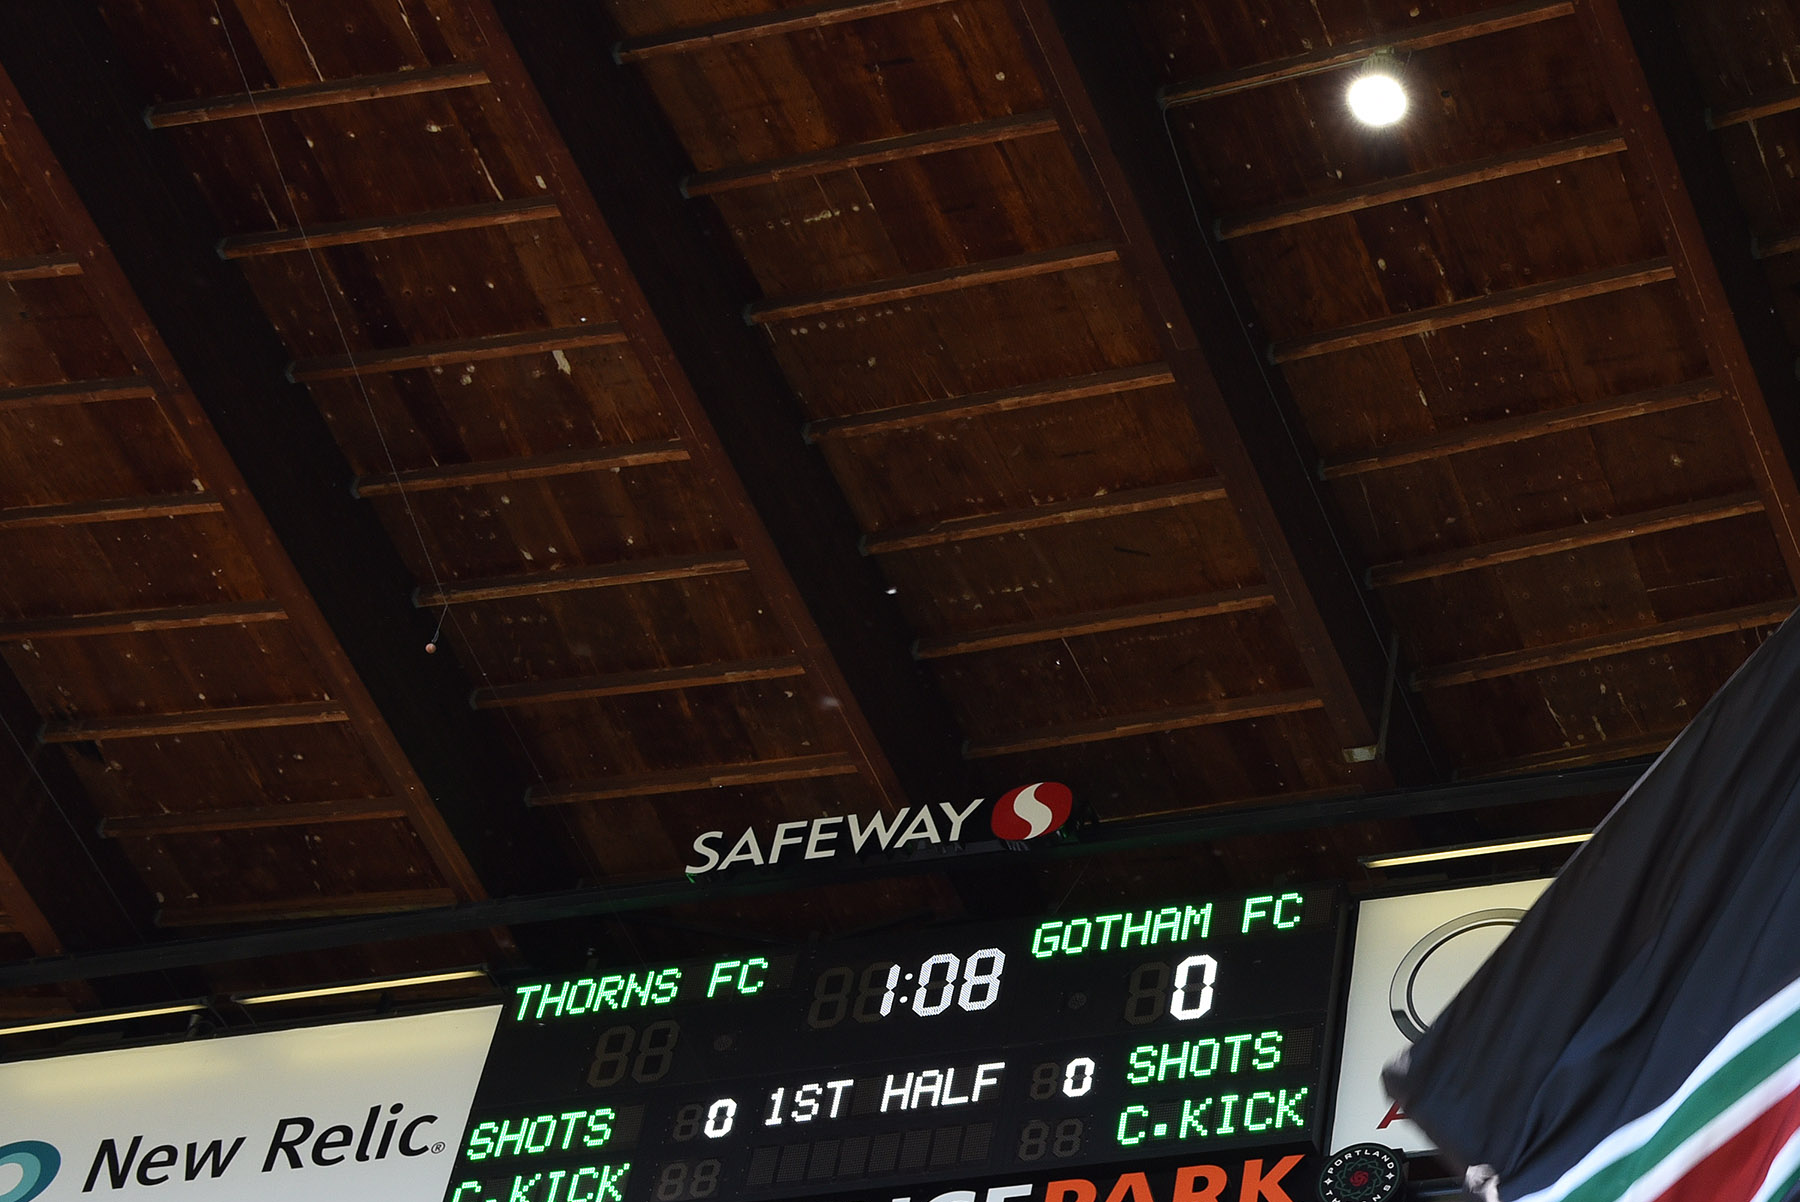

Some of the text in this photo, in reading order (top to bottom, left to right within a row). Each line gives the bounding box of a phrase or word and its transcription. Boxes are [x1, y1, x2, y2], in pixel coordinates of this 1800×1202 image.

[686, 797, 985, 876] SAFEWAY
[1030, 892, 1304, 960] GOTHAM FC
[515, 957, 769, 1021] THORNS FC
[879, 947, 1006, 1018] 1:08
[1170, 953, 1218, 1021] 0
[1061, 1057, 1095, 1098] 0
[1127, 1030, 1284, 1086] SHOTS
[703, 1098, 738, 1139] 0
[764, 1062, 1006, 1127] 1ST HALF
[1116, 1086, 1309, 1147] C.KICK
[82, 1132, 245, 1194] New
[466, 1107, 616, 1162] SHOTS
[1327, 1149, 1395, 1174] PORTLAND
